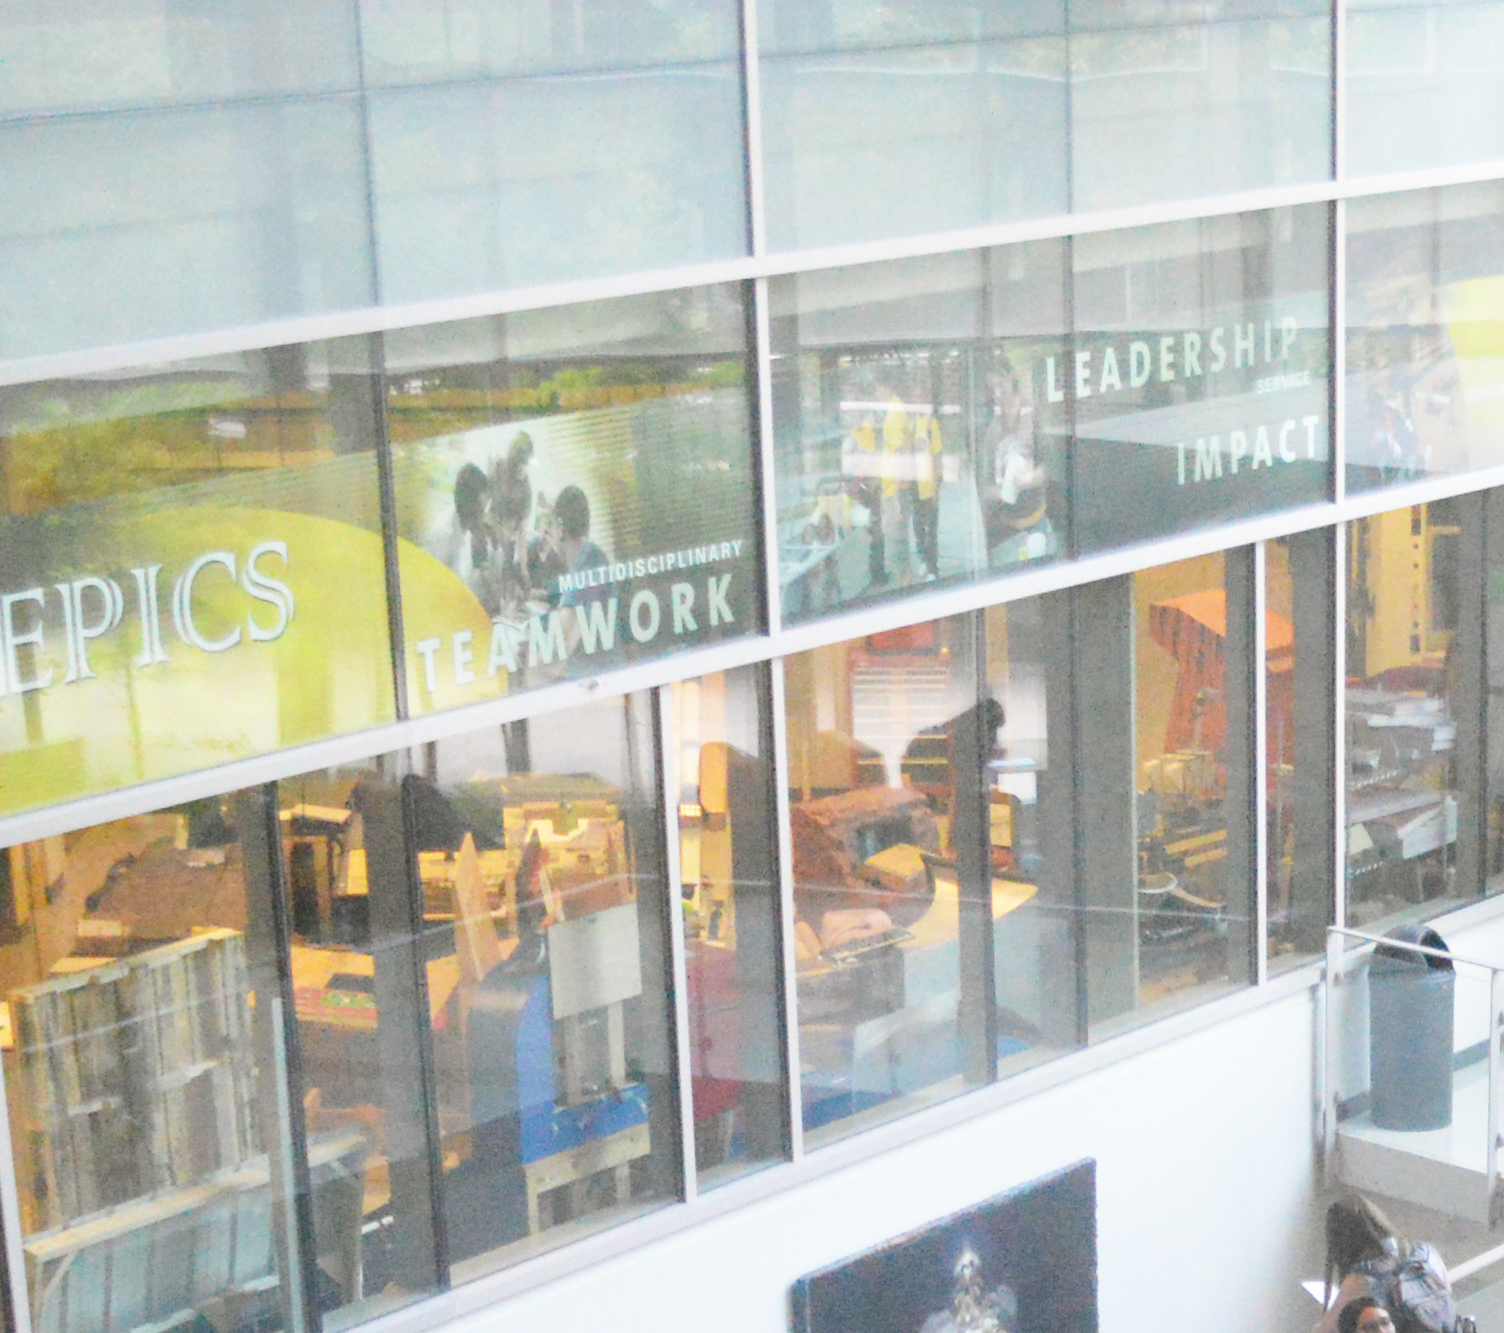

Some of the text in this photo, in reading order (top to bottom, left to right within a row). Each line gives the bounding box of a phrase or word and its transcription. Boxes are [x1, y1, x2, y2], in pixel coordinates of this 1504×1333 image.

[1046, 315, 1298, 404] LEADERSHIP
[1256, 370, 1310, 394] SERVICE
[1176, 414, 1320, 485] IMPACT
[558, 540, 743, 593] MULTIDISCIPLINARY
[416, 573, 735, 692] TEAMWORK
